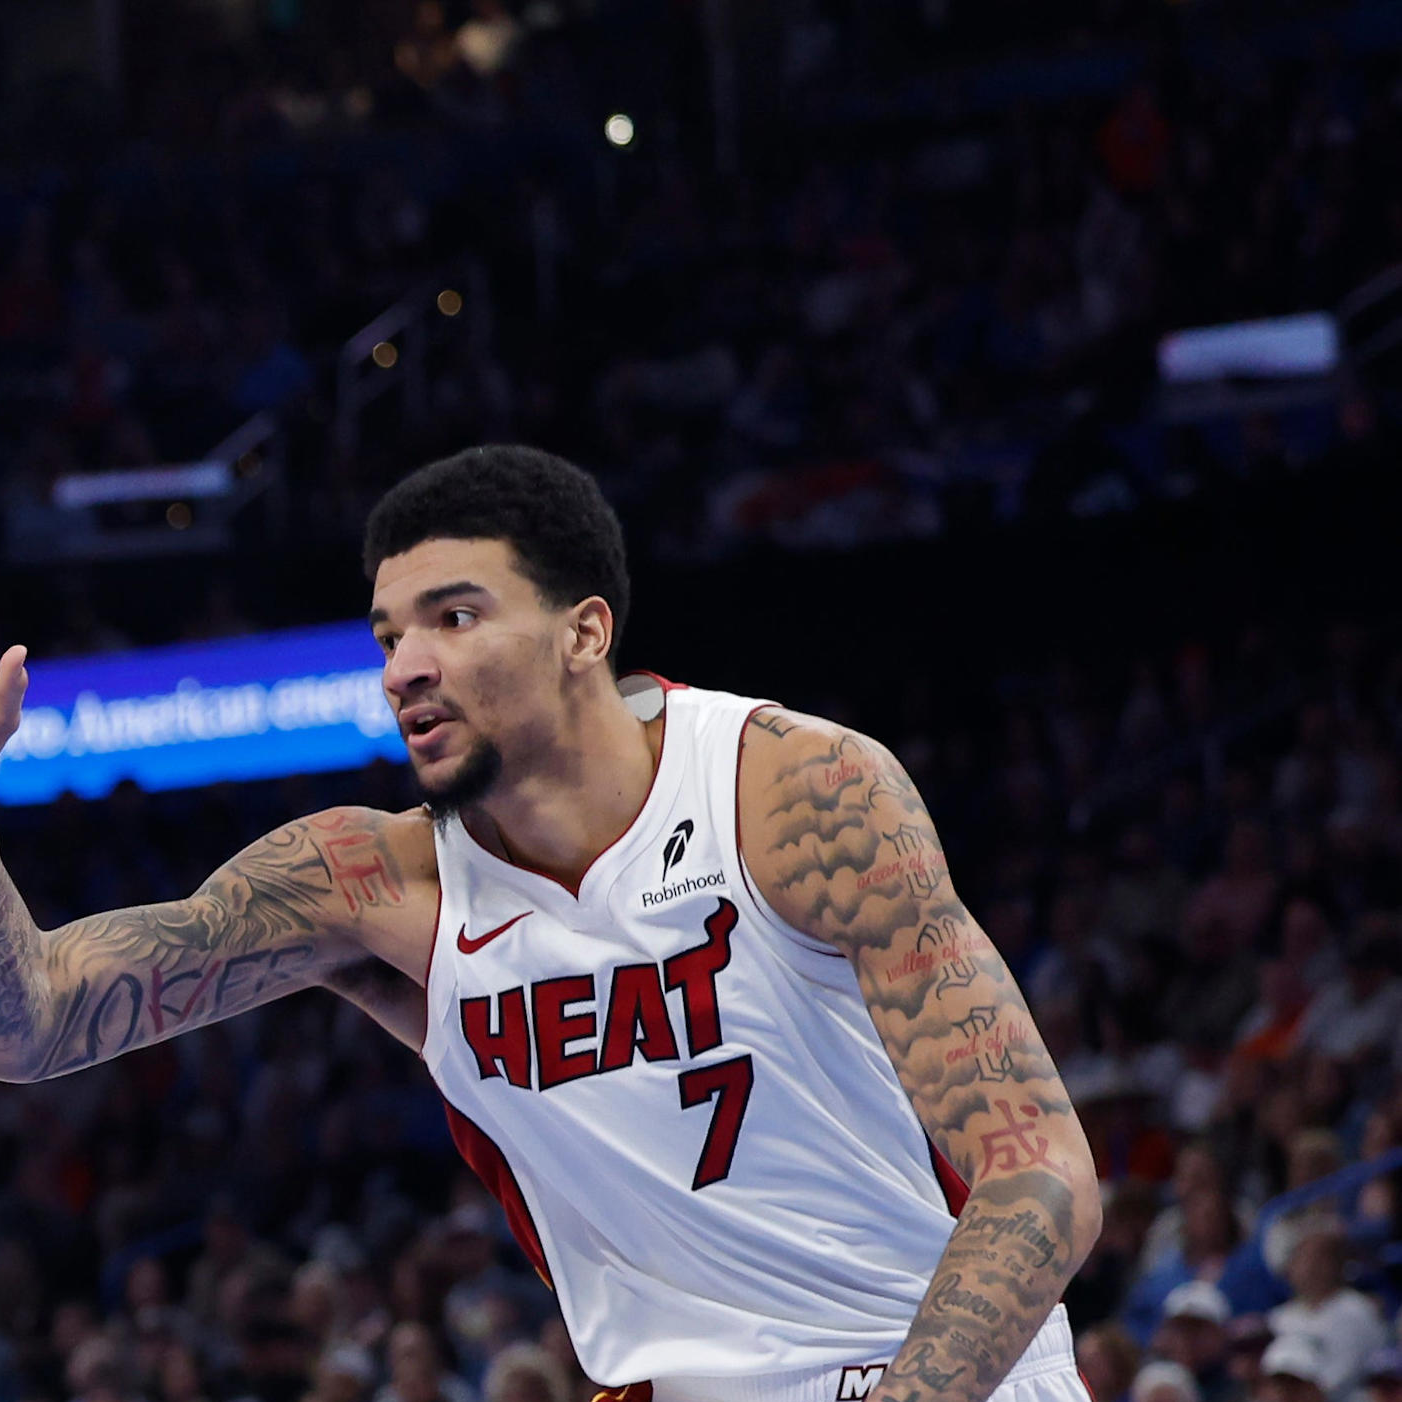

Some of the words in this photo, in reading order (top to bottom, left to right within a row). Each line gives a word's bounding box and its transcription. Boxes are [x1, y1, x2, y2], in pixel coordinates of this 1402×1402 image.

[642, 869, 726, 908] Robinhood
[459, 896, 739, 1092] HEAT
[677, 1053, 754, 1192] 7
[836, 1363, 888, 1402] M
